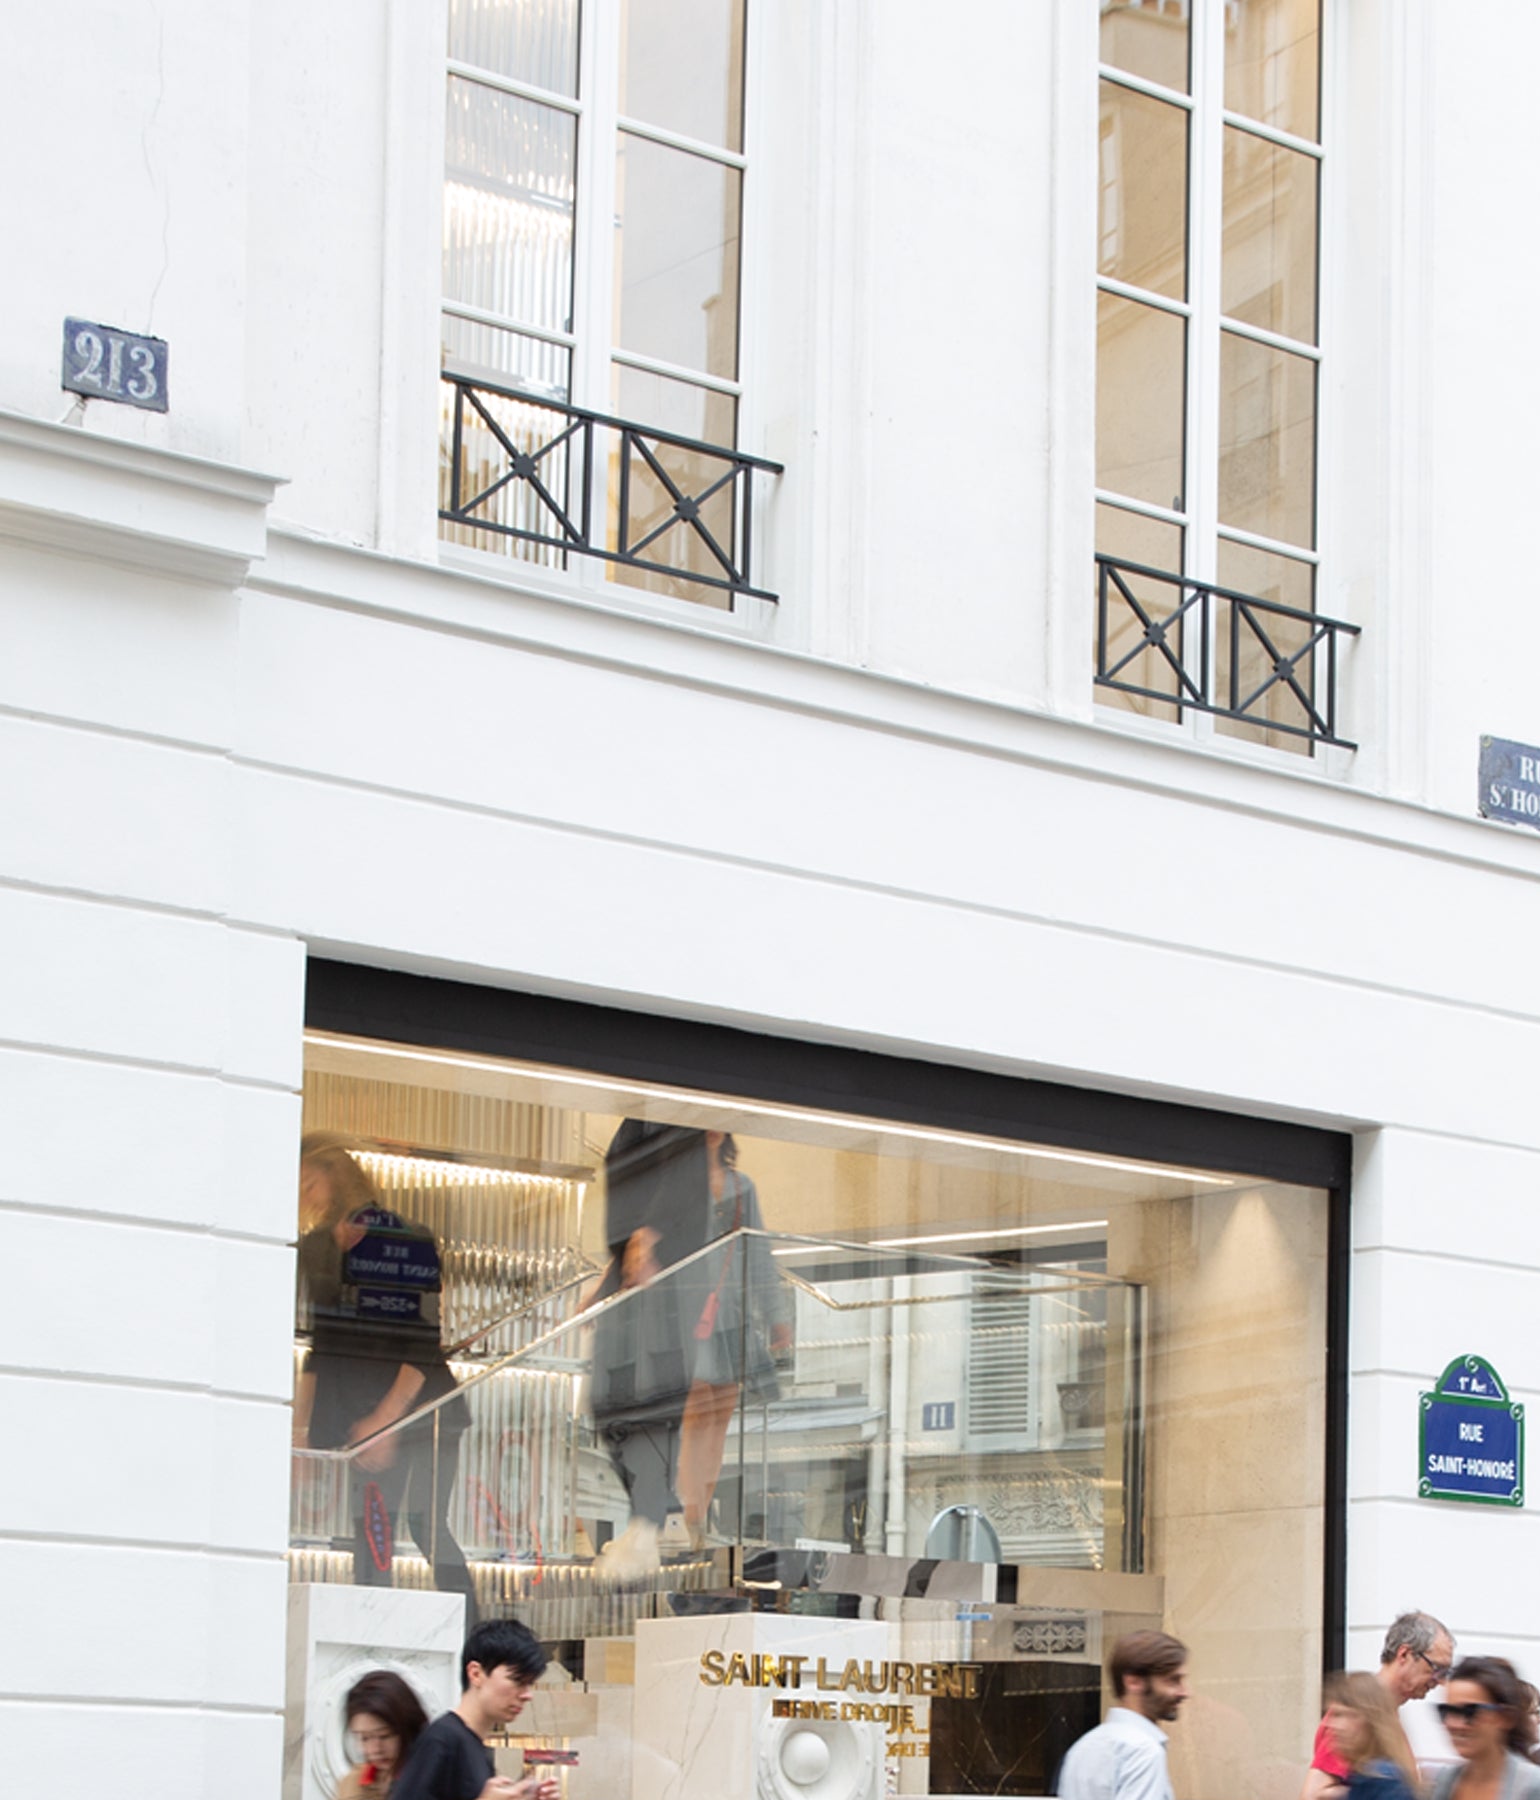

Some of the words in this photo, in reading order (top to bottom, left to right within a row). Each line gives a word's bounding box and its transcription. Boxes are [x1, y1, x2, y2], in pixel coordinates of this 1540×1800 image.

[73, 330, 157, 400] 213
[1458, 1422, 1484, 1442] RUE
[1427, 1454, 1516, 1481] SAINT-HONORÉ
[699, 1649, 809, 1689] SAINT
[816, 1656, 983, 1700] LAURENT
